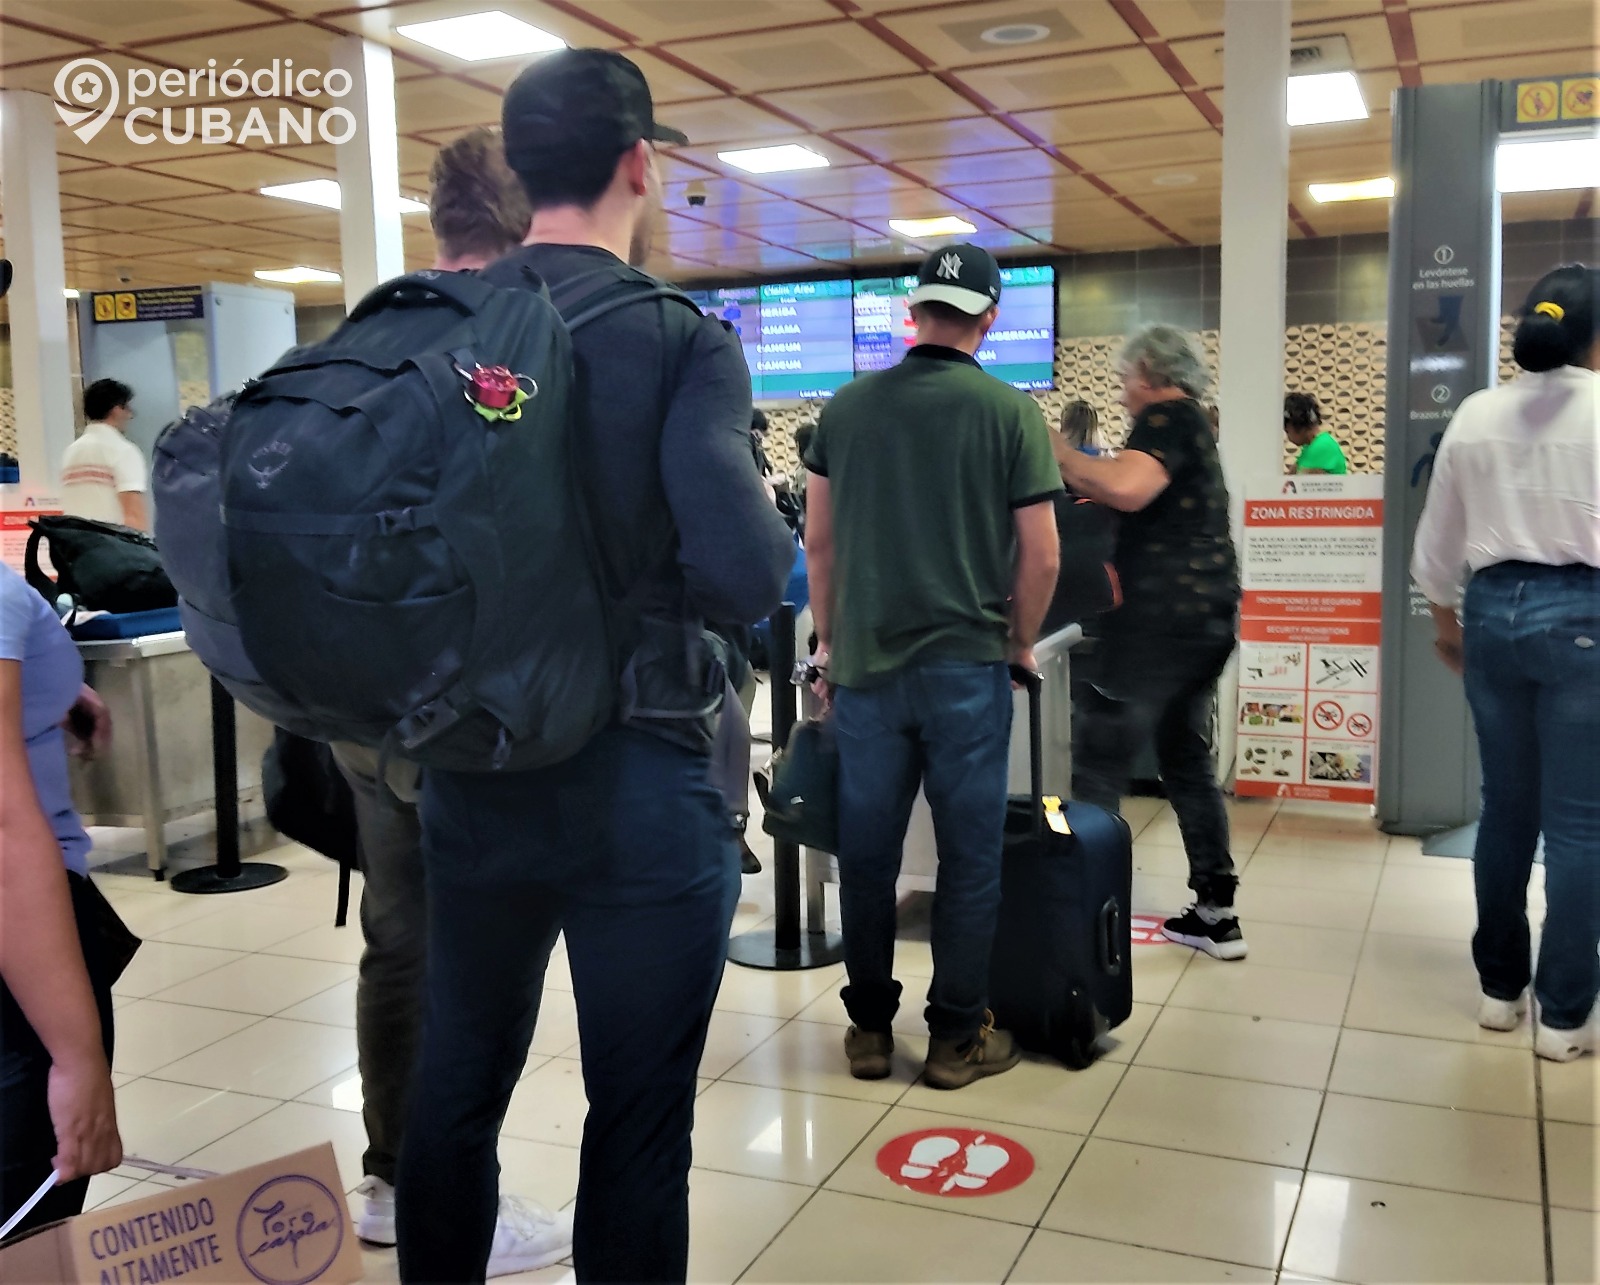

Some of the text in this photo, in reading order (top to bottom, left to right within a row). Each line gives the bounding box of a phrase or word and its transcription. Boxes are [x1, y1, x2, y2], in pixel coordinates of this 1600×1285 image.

[1250, 506, 1375, 520] ZONA RESTRINGIDA
[89, 1197, 214, 1261] CONTENIDO
[99, 1233, 223, 1285] ALTAMENTE
